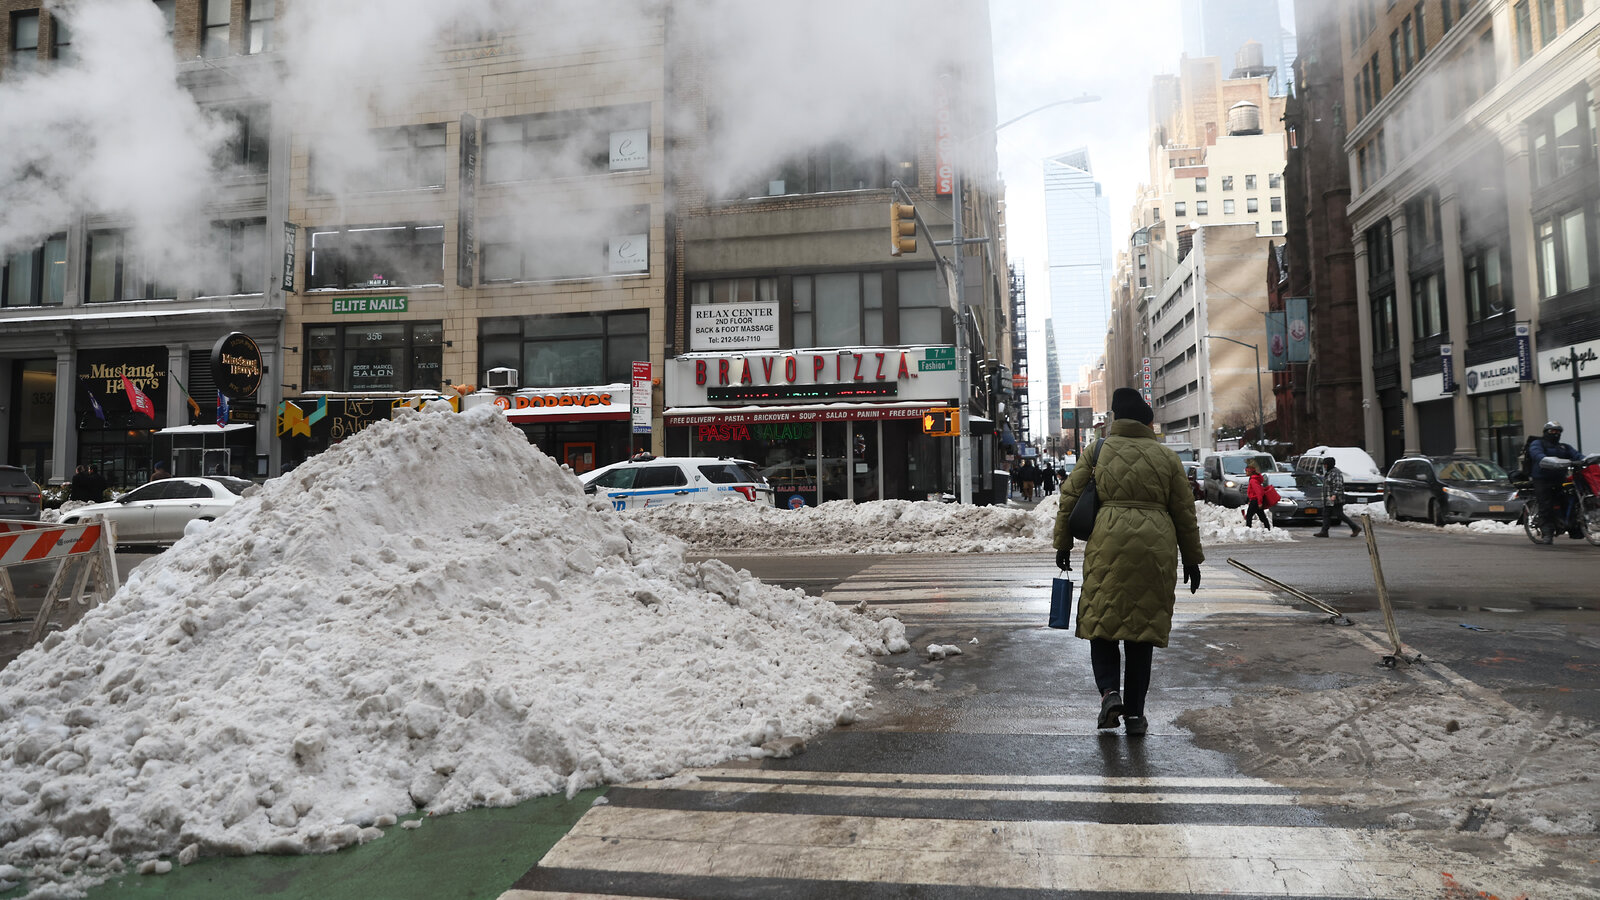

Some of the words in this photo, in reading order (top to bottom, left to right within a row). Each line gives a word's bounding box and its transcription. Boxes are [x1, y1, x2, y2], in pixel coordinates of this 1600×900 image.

[285, 233, 295, 287] NAILS
[334, 300, 367, 312] ELITE
[369, 298, 405, 311] NAILS
[696, 309, 729, 319] RELAX
[731, 308, 773, 318] CENTER
[740, 324, 774, 332] MASSAGE
[366, 332, 382, 341] 356
[720, 335, 761, 343] 212-564-7110
[934, 349, 939, 358] 7
[1518, 339, 1526, 377] MULLIGAN
[90, 363, 155, 380] Mustang
[695, 355, 797, 386] BRAVO
[813, 352, 911, 382] PIZZA
[921, 361, 946, 370] Fashion
[1480, 364, 1519, 379] MULLIGAN
[353, 369, 394, 377] SALON
[1143, 358, 1151, 388] PARK
[685, 416, 716, 424] DELIVERY
[753, 413, 790, 421] BRICKOVEN
[799, 412, 817, 420] SOUP
[825, 411, 848, 419] SALAD
[857, 410, 880, 418] PANINI
[889, 409, 906, 417] FREE
[698, 424, 751, 442] PASTA
